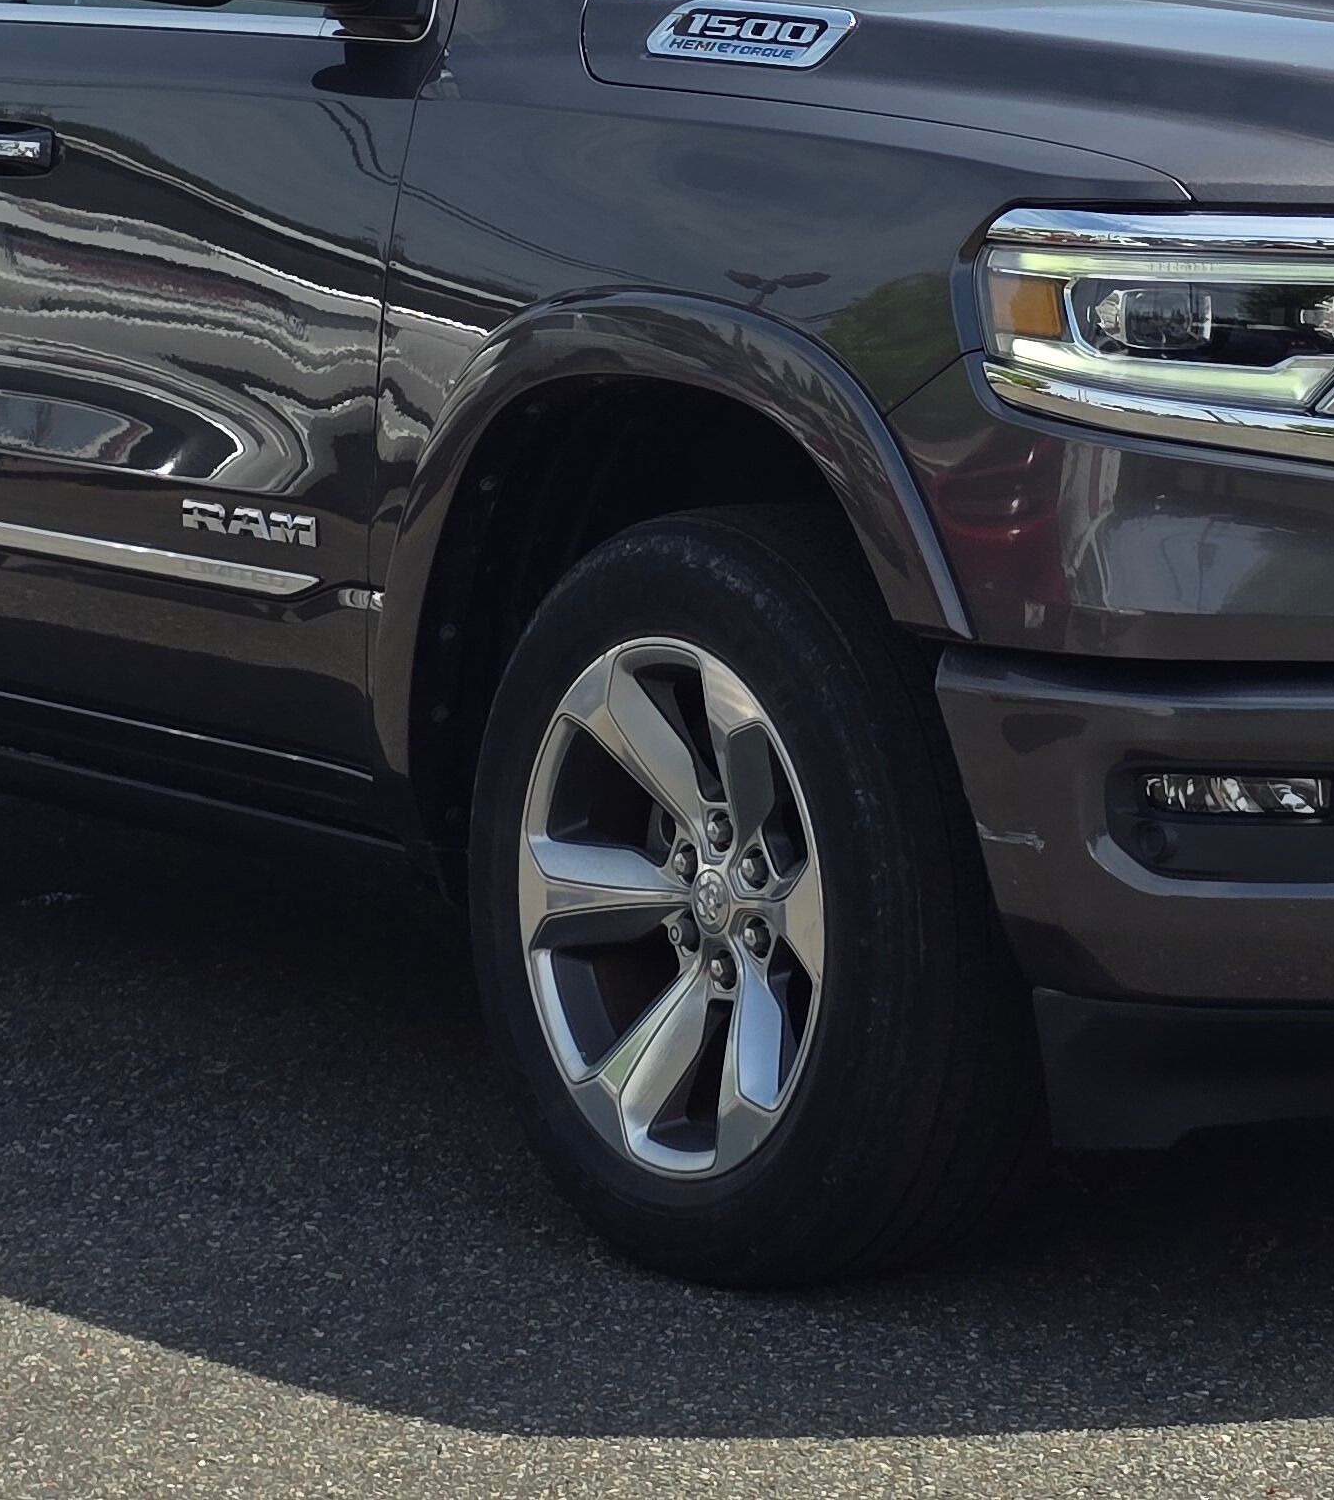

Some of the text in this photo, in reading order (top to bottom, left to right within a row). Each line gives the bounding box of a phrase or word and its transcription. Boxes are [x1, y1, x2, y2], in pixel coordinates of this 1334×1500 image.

[687, 13, 820, 44] 1500
[669, 37, 716, 52] HEMI
[182, 499, 317, 548] RAM
